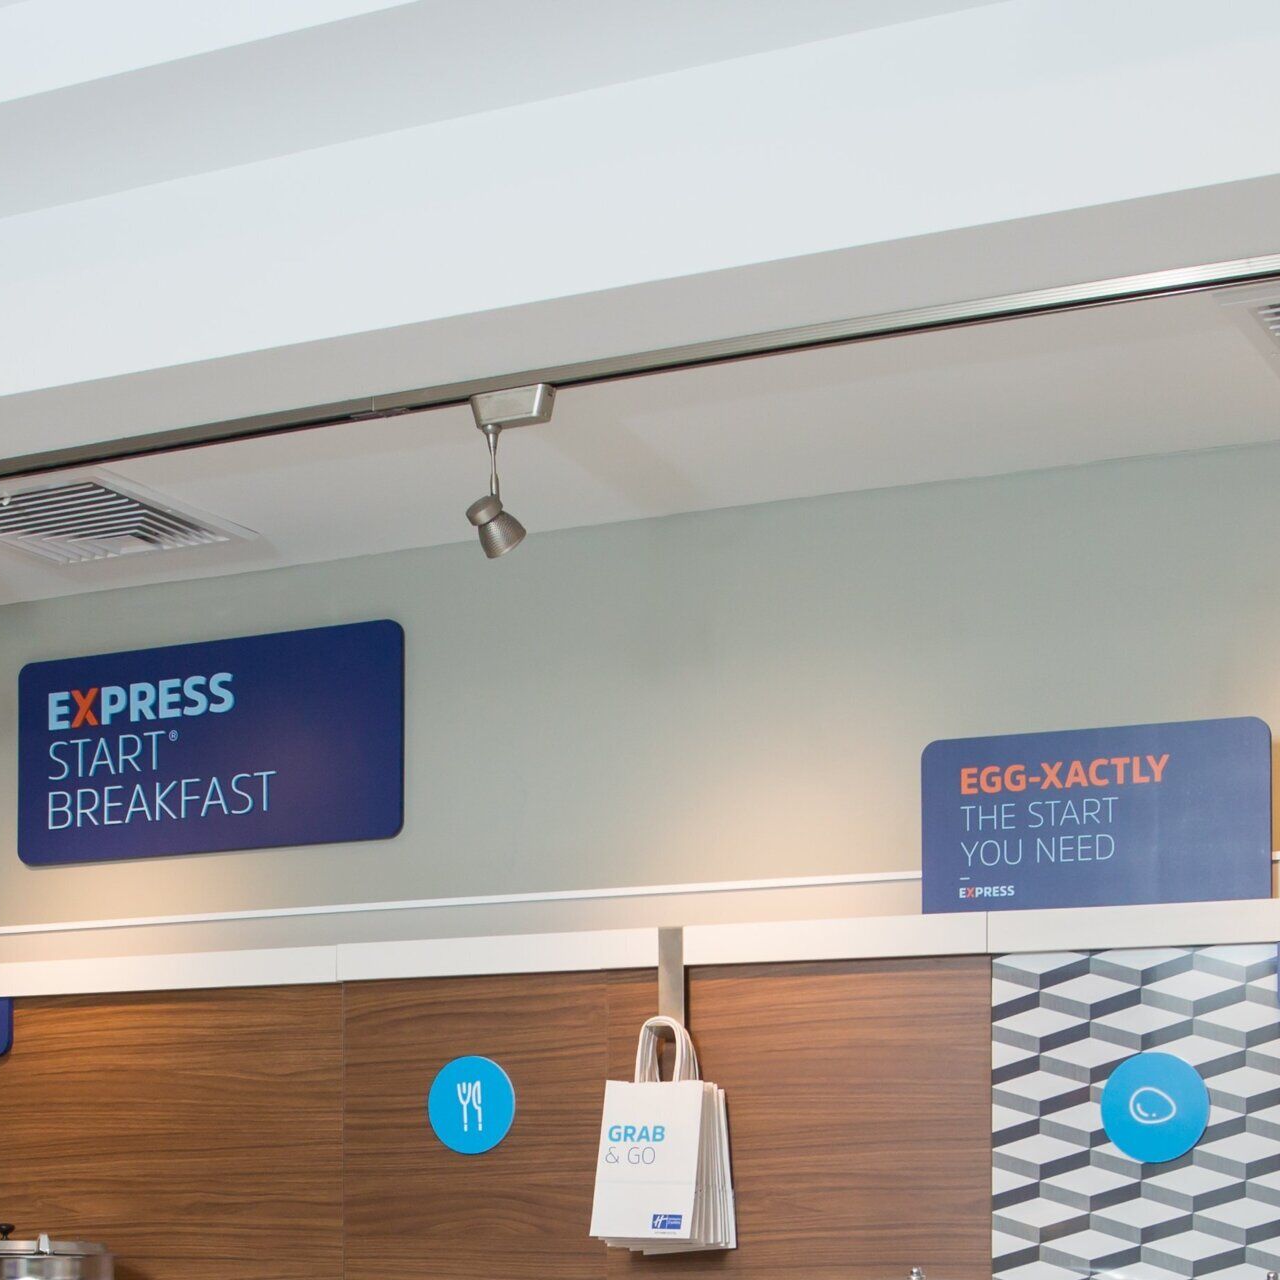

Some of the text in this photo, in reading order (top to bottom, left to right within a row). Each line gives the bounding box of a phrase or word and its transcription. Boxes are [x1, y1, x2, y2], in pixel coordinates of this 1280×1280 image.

[48, 672, 235, 732] EXPRESS
[959, 753, 1170, 795] EGG-XACTLY
[48, 770, 277, 830] BREAKFAST
[960, 797, 1119, 832] THE START
[960, 834, 1115, 868] YOU NEED
[959, 884, 1015, 899] EXPRESS
[608, 1124, 666, 1143] GRAB
[605, 1146, 656, 1165] & GO
